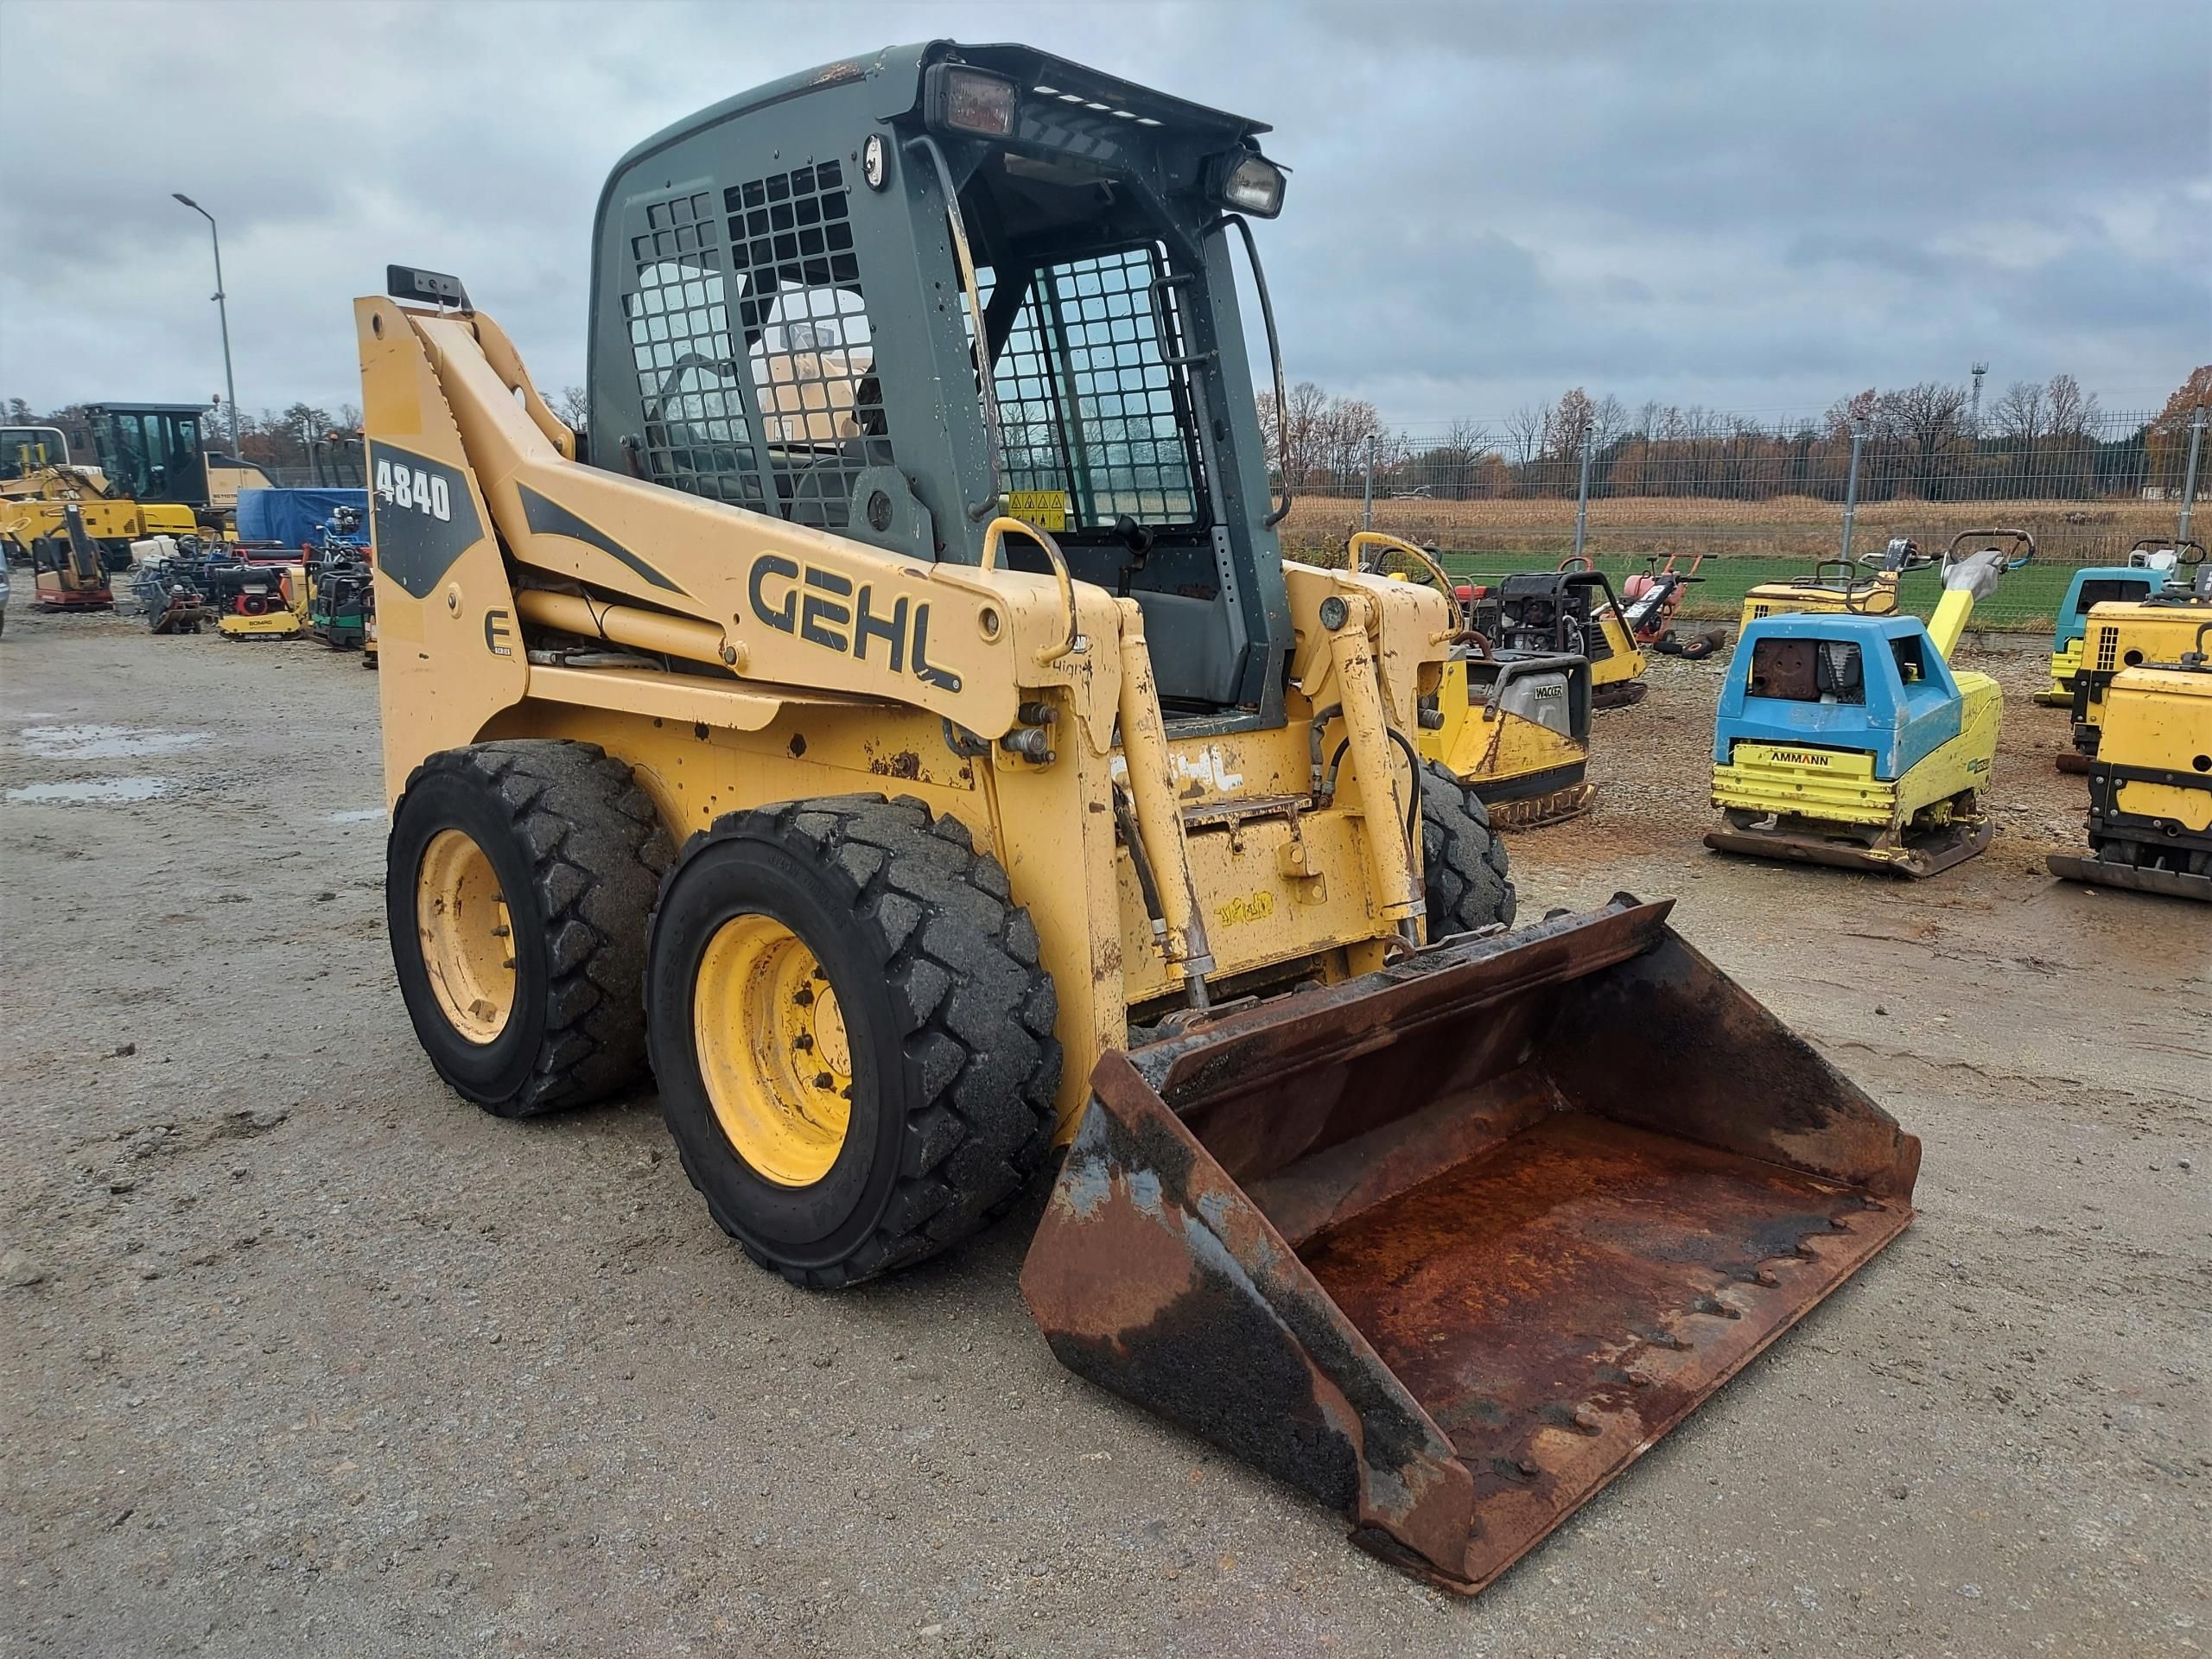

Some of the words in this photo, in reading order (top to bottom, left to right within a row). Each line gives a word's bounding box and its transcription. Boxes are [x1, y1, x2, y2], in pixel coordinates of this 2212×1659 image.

[377, 458, 451, 522] 4840
[748, 554, 963, 693] GEHL
[1771, 752, 1828, 766] AMMANN
